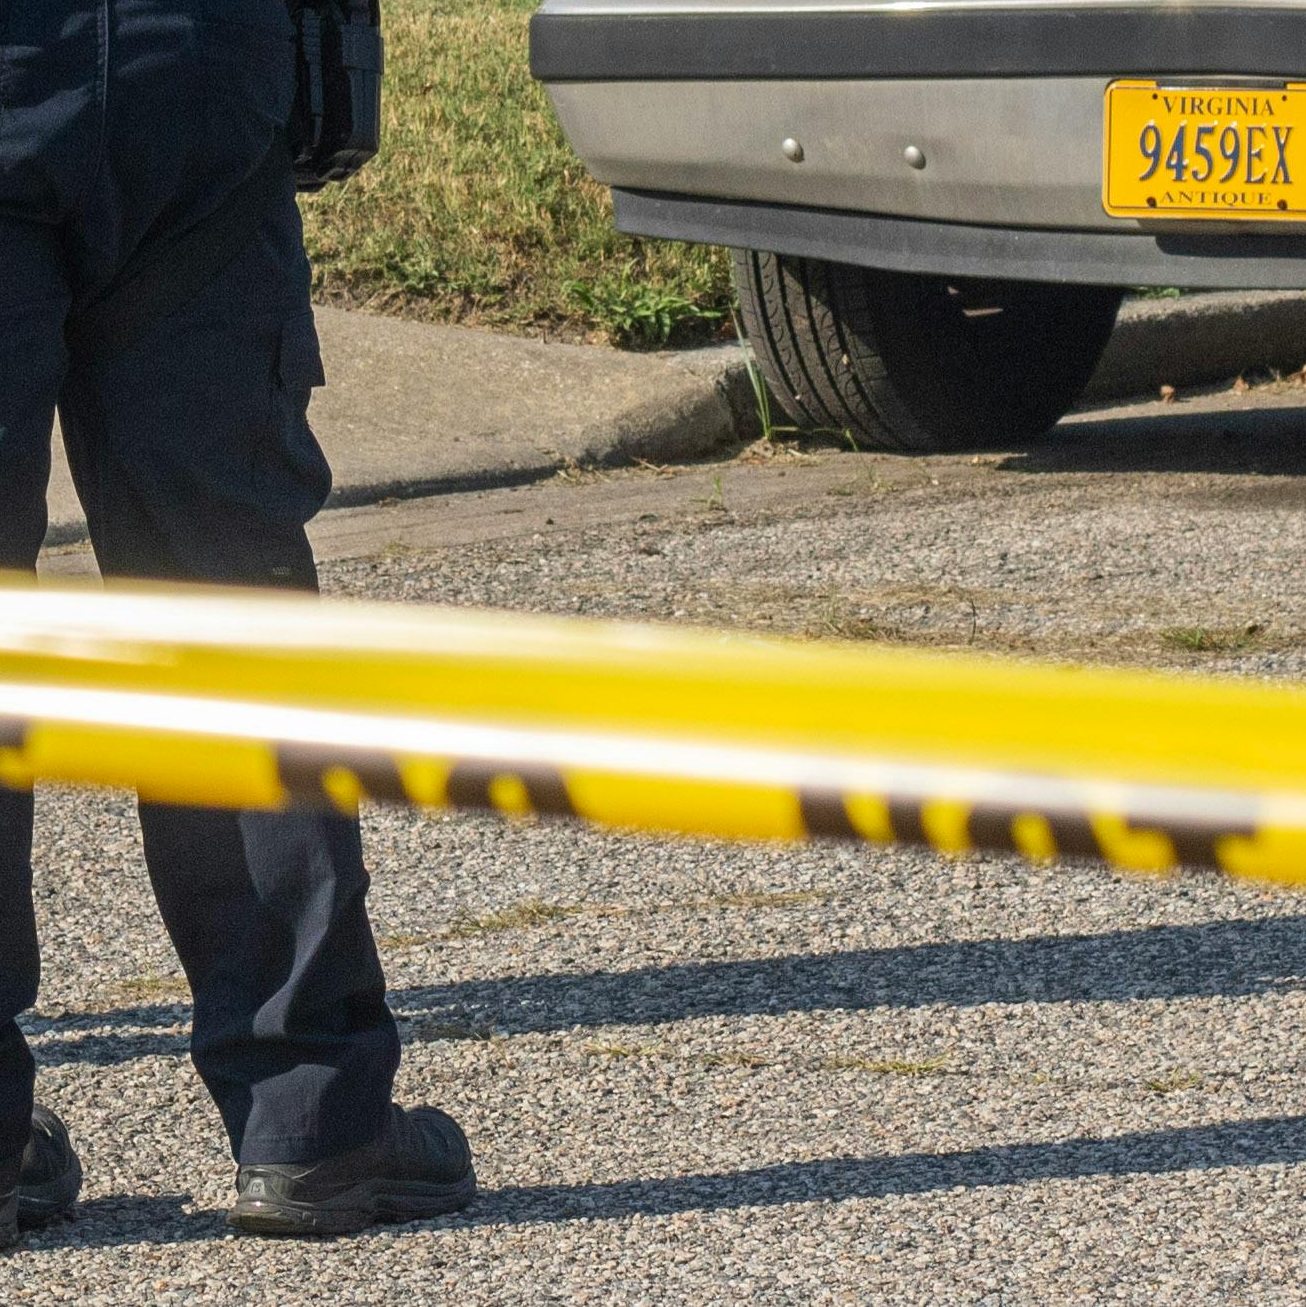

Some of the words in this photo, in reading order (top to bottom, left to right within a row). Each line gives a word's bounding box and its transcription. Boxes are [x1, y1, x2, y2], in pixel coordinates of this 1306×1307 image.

[1162, 95, 1275, 116] VIRGINIA
[1139, 121, 1293, 184] 9459EX
[1160, 190, 1272, 207] ANTIQUE
